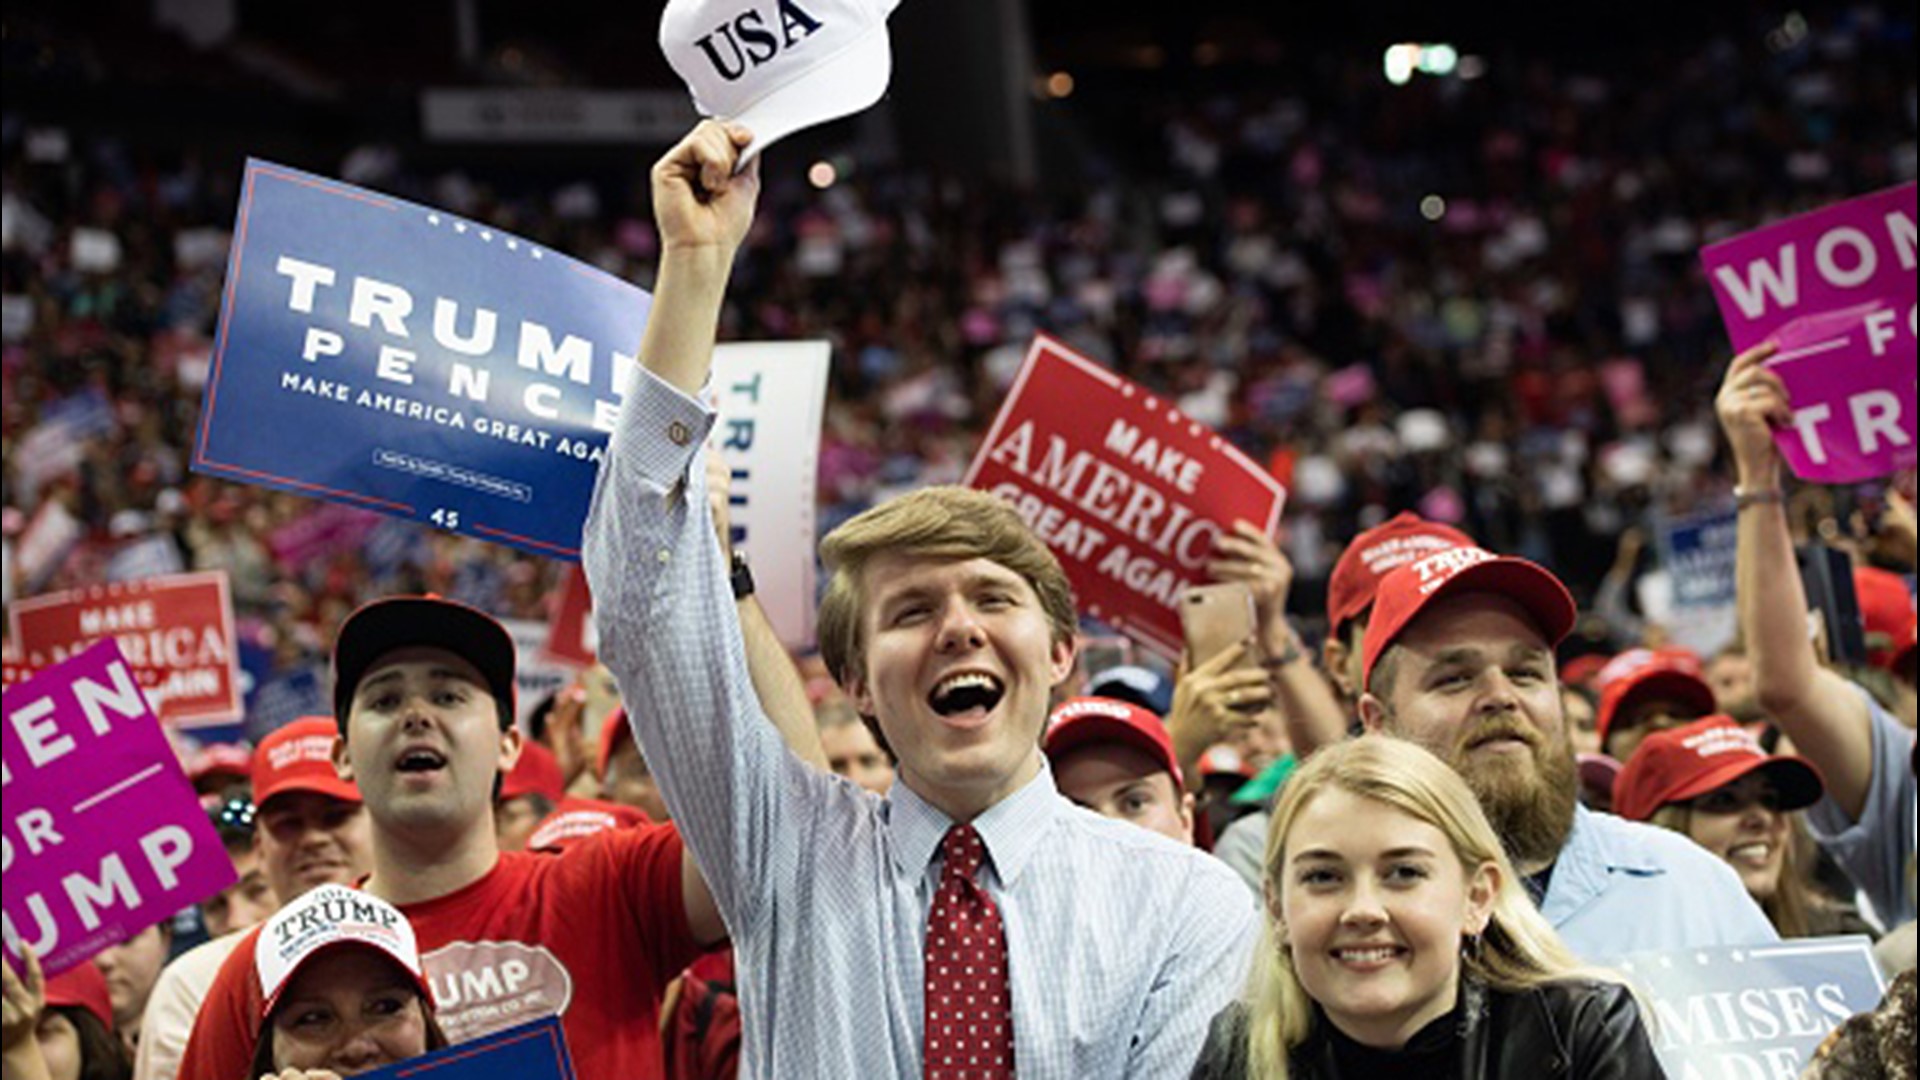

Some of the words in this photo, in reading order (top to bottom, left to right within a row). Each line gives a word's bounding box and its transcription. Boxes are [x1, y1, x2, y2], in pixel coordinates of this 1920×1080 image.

[694, 0, 823, 81] USA
[1863, 303, 1917, 356] F
[281, 372, 350, 402] MAKE
[356, 388, 466, 430] AMERICA
[473, 417, 552, 450] GREAT
[1793, 378, 1917, 465] TR
[1104, 418, 1204, 495] MAKE
[430, 507, 459, 529] 45
[79, 602, 155, 634] MAKE
[2, 659, 147, 786] EN
[274, 899, 398, 946] TRUMP
[428, 959, 529, 1008] UMP
